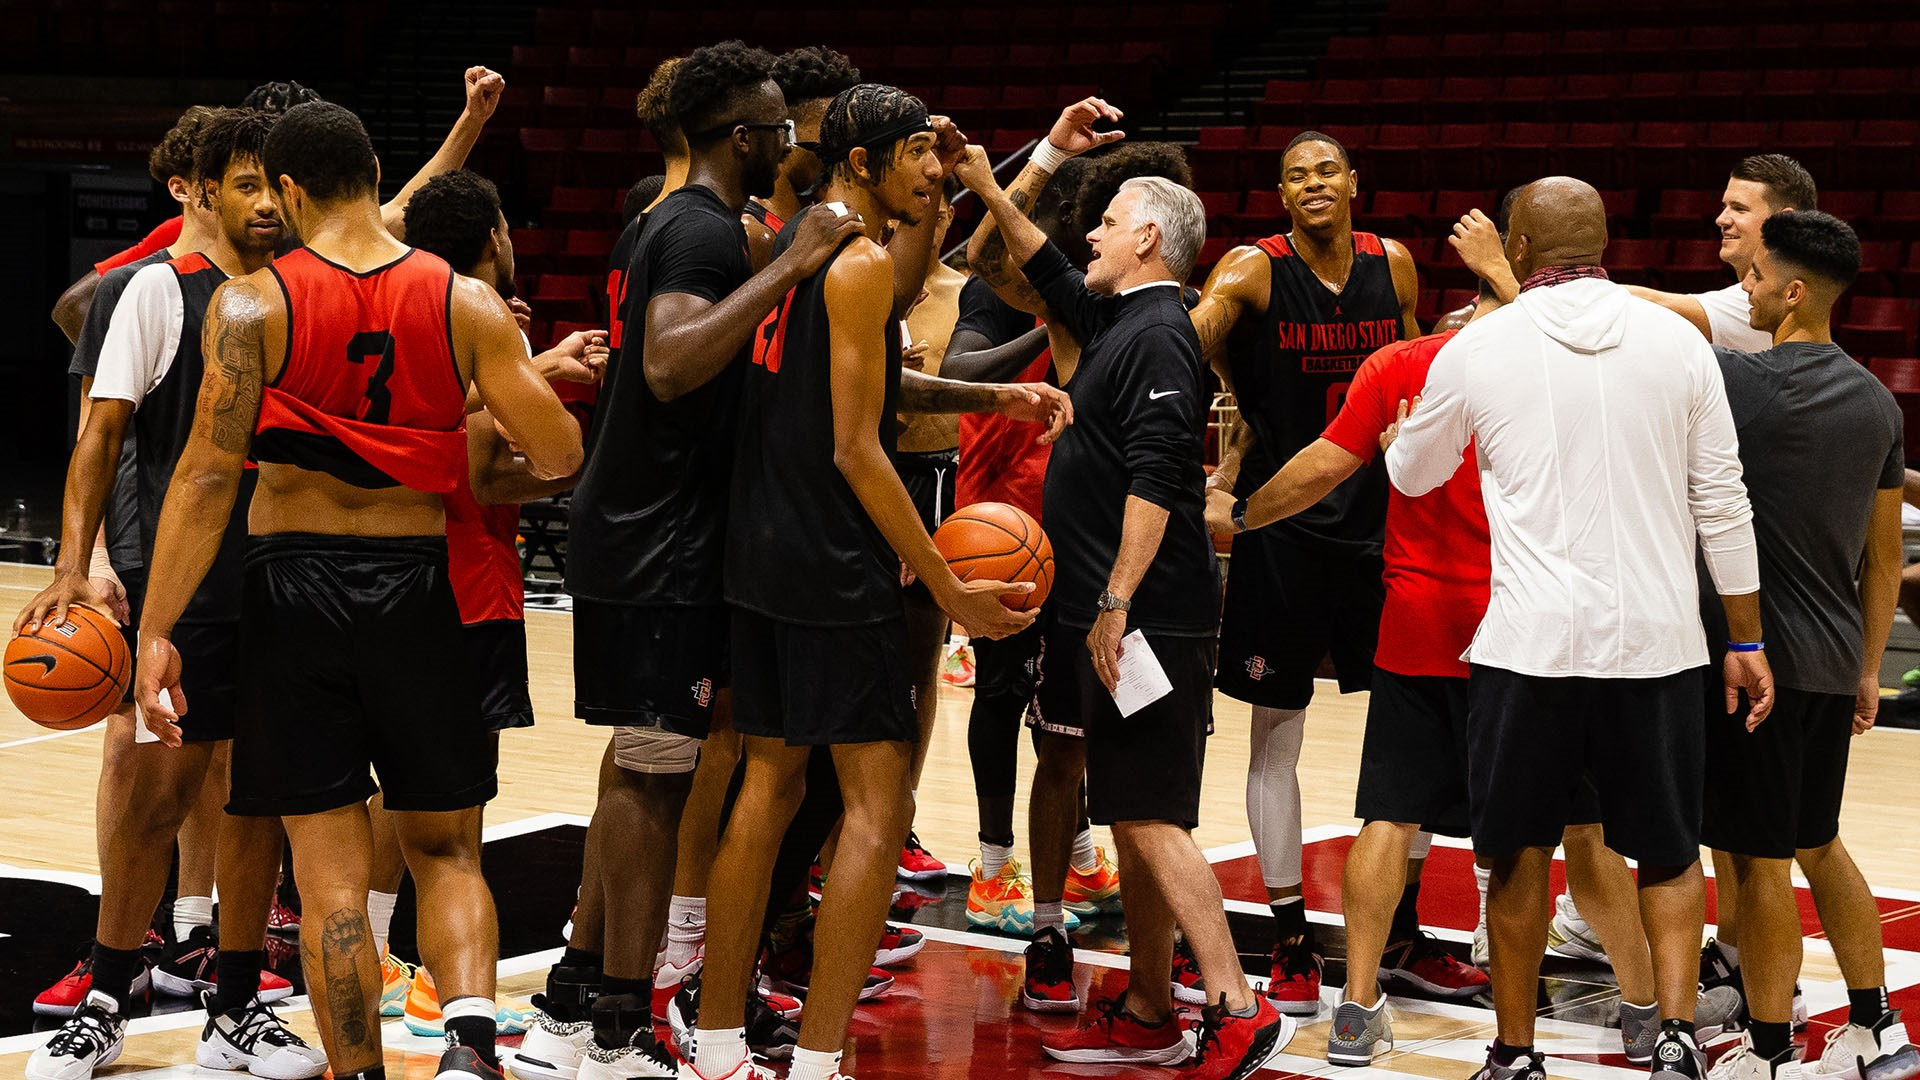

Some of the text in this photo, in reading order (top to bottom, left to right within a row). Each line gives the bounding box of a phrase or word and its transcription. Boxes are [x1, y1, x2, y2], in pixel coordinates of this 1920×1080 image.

[1279, 318, 1396, 350] SAN DIEGO STATE
